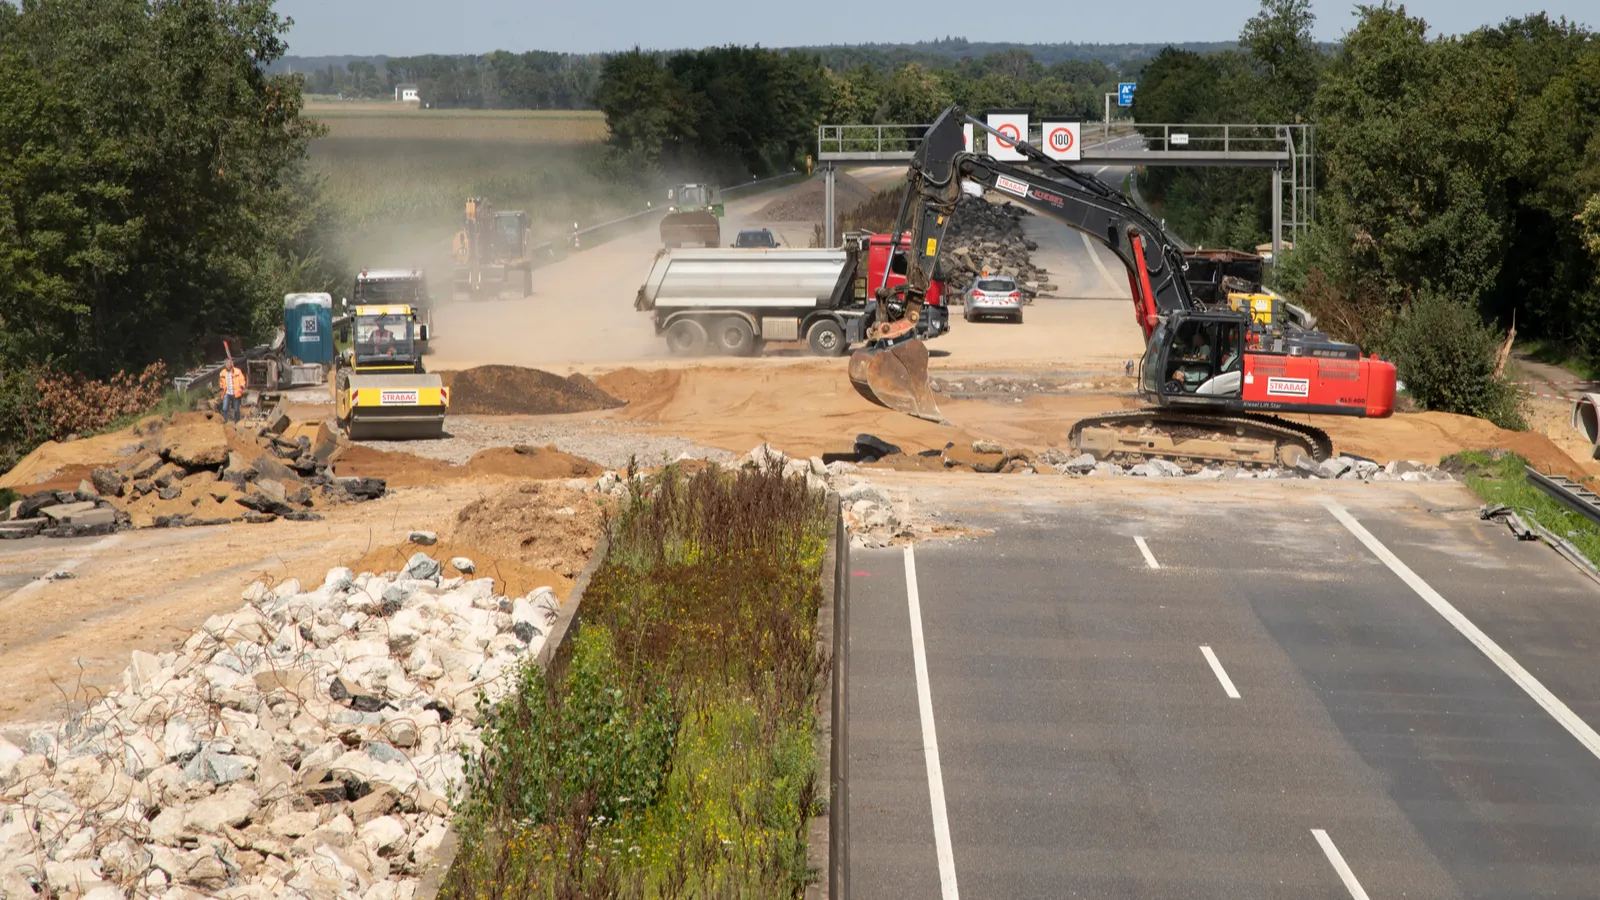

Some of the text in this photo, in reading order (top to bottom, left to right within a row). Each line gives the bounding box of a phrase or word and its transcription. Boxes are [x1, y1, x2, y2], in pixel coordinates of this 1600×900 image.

[1054, 134, 1069, 146] 100
[998, 178, 1026, 192] STRABAG
[1270, 382, 1307, 391] STRABAG
